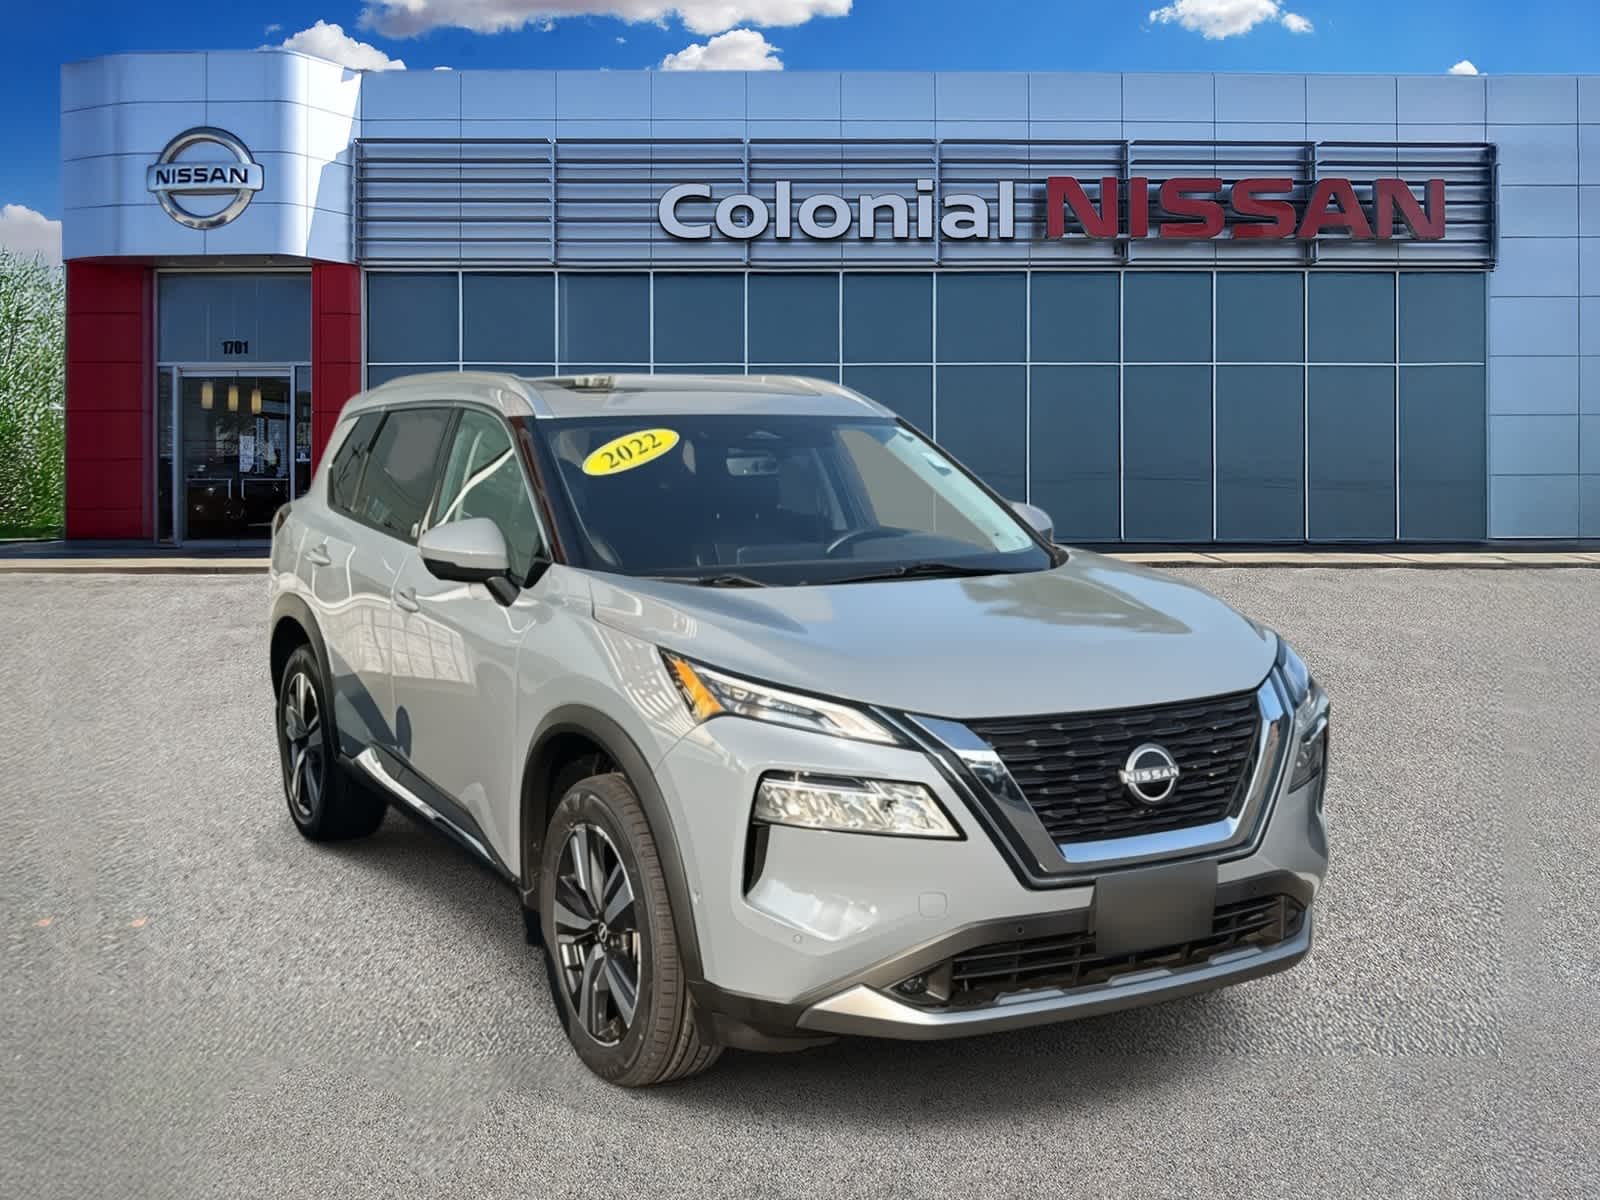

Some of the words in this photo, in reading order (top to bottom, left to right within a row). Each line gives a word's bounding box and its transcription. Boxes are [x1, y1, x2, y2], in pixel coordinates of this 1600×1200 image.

[155, 167, 249, 185] NISSAN
[658, 179, 1015, 239] Colonial
[1045, 176, 1446, 240] NISSAN
[222, 341, 249, 354] 1701
[600, 433, 663, 469] 2022
[1127, 767, 1180, 782] NISSAN
